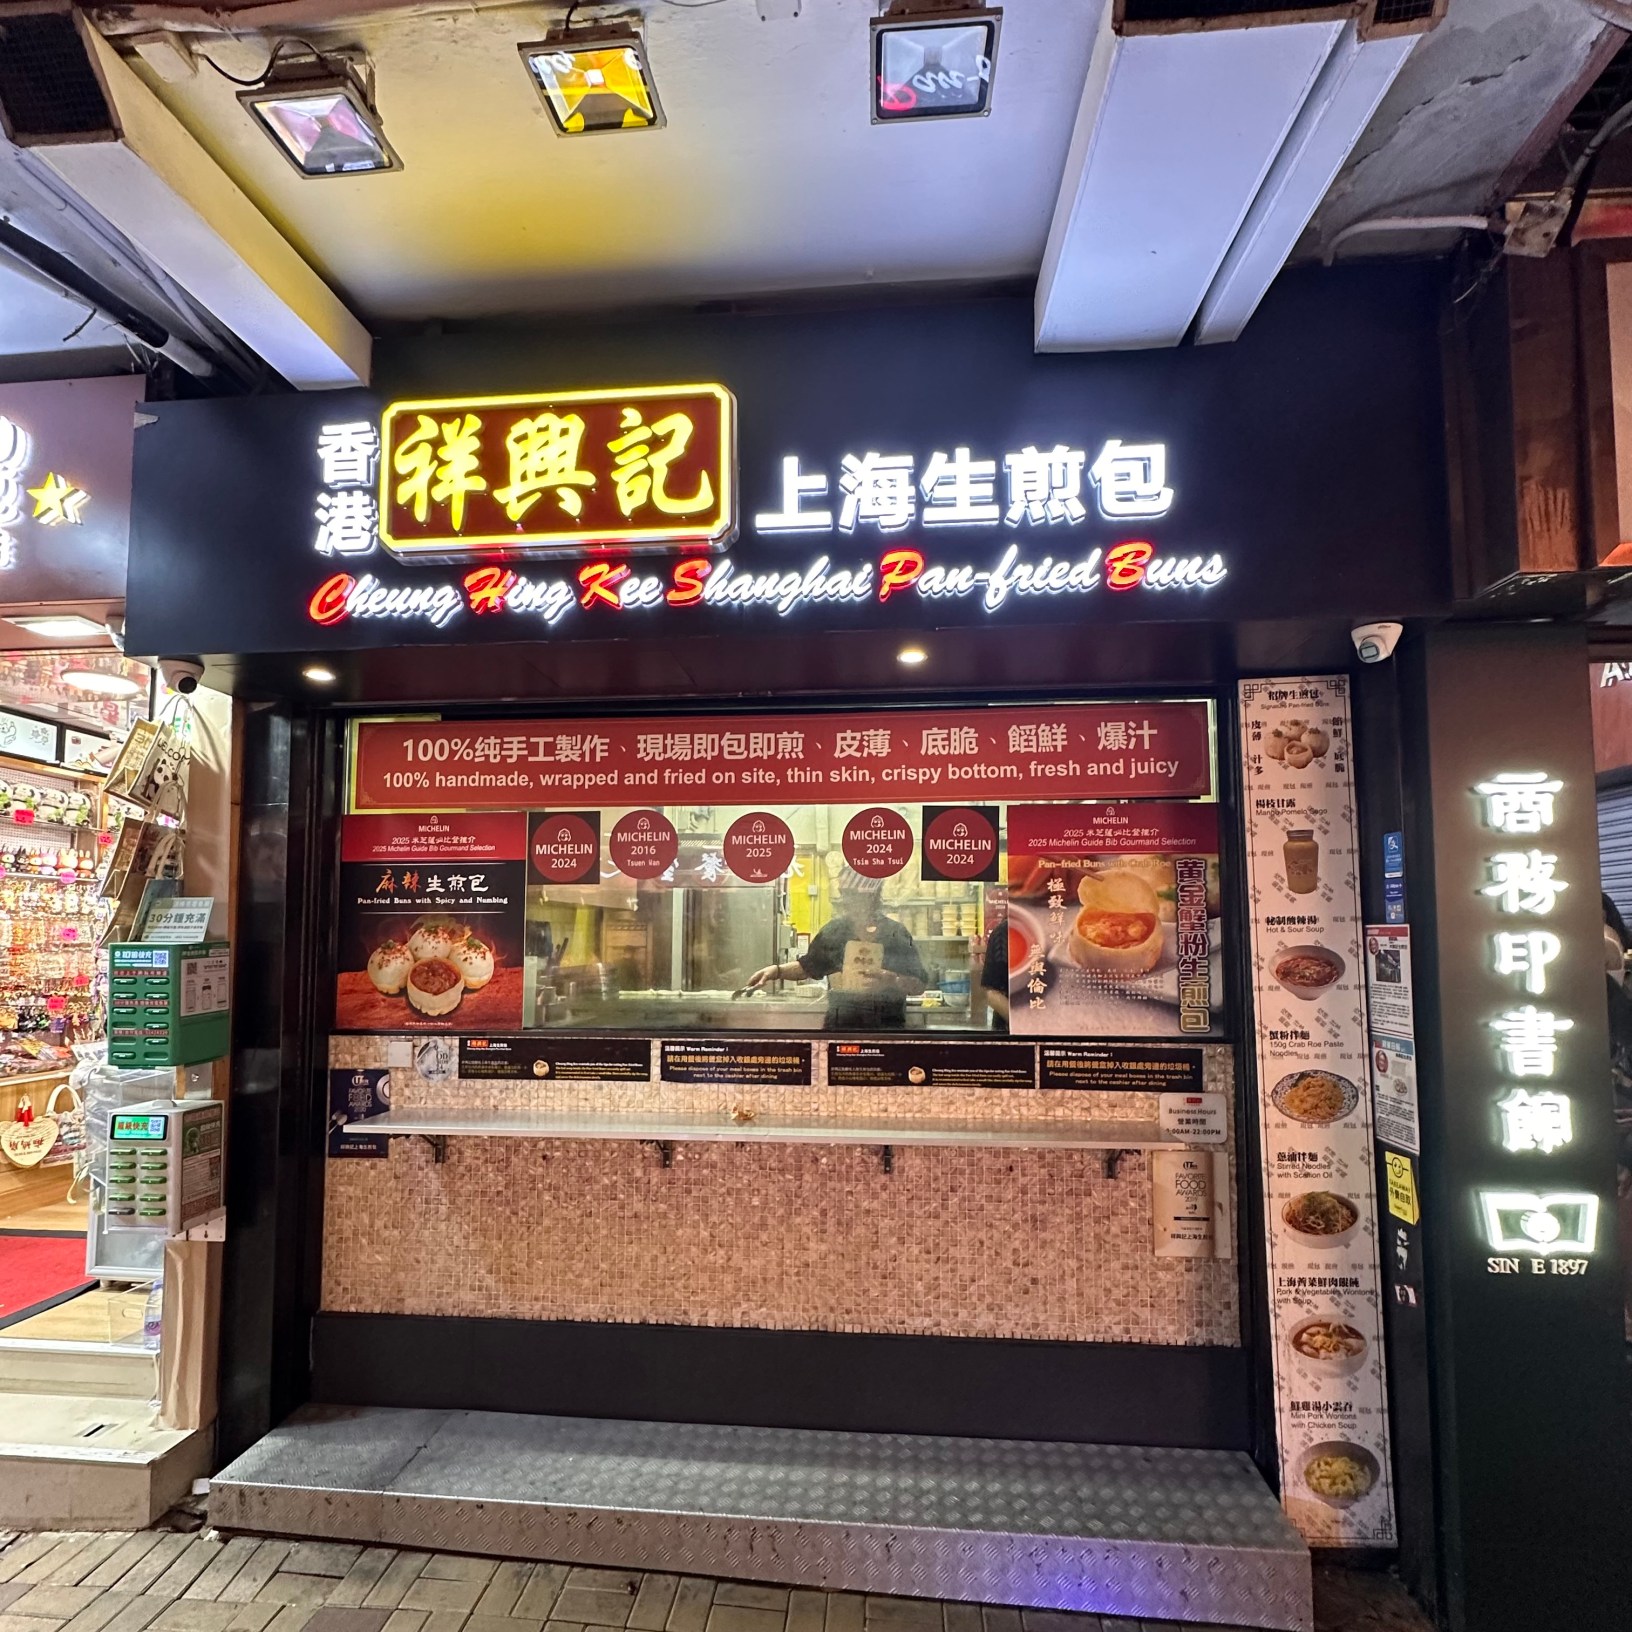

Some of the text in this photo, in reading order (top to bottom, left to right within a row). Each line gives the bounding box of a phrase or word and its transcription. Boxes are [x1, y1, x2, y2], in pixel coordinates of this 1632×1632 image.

[394, 407, 713, 531] 祥興記
[315, 421, 378, 556] 香港
[755, 440, 1174, 534] 上海生煎包
[310, 541, 1227, 628] Cheung Hing Kee Shanghai Pan-fried Buns
[383, 759, 1179, 790] 100% handmade, wrapped and fried on site, thin skin, crispy bottom, fresh and juicy
[418, 825, 450, 833] MICHELIN
[1063, 829, 1084, 837] 2025
[617, 832, 671, 842] MICHELIN
[731, 834, 786, 845] MICHELIN
[850, 830, 905, 841] MICHELIN
[391, 837, 409, 845] 2025
[929, 839, 991, 851] MICHELIN
[1049, 838, 1079, 846] Michelin
[1081, 838, 1103, 846] Guide
[1161, 837, 1196, 845] Selection
[388, 844, 411, 852] Michelin
[411, 844, 428, 852] Guide
[439, 844, 469, 852] Gourmand
[536, 843, 593, 855] MICHELIN
[631, 846, 656, 855] 2016
[746, 848, 772, 858] 2025
[866, 844, 892, 854] 2024
[551, 858, 577, 868] 2024
[946, 854, 974, 864] 2024
[1038, 860, 1081, 868] Pan-fried
[1083, 860, 1105, 868] Buns
[435, 897, 455, 905] Spicy
[476, 896, 508, 905] Numbing
[1047, 877, 1067, 944] 極致鮮味
[1306, 926, 1324, 934] Soup
[1473, 772, 1573, 1152] 商務印書館
[1175, 1180, 1206, 1189] FOOD
[1550, 1258, 1588, 1275] 1897
[1338, 1422, 1357, 1430] Soup
